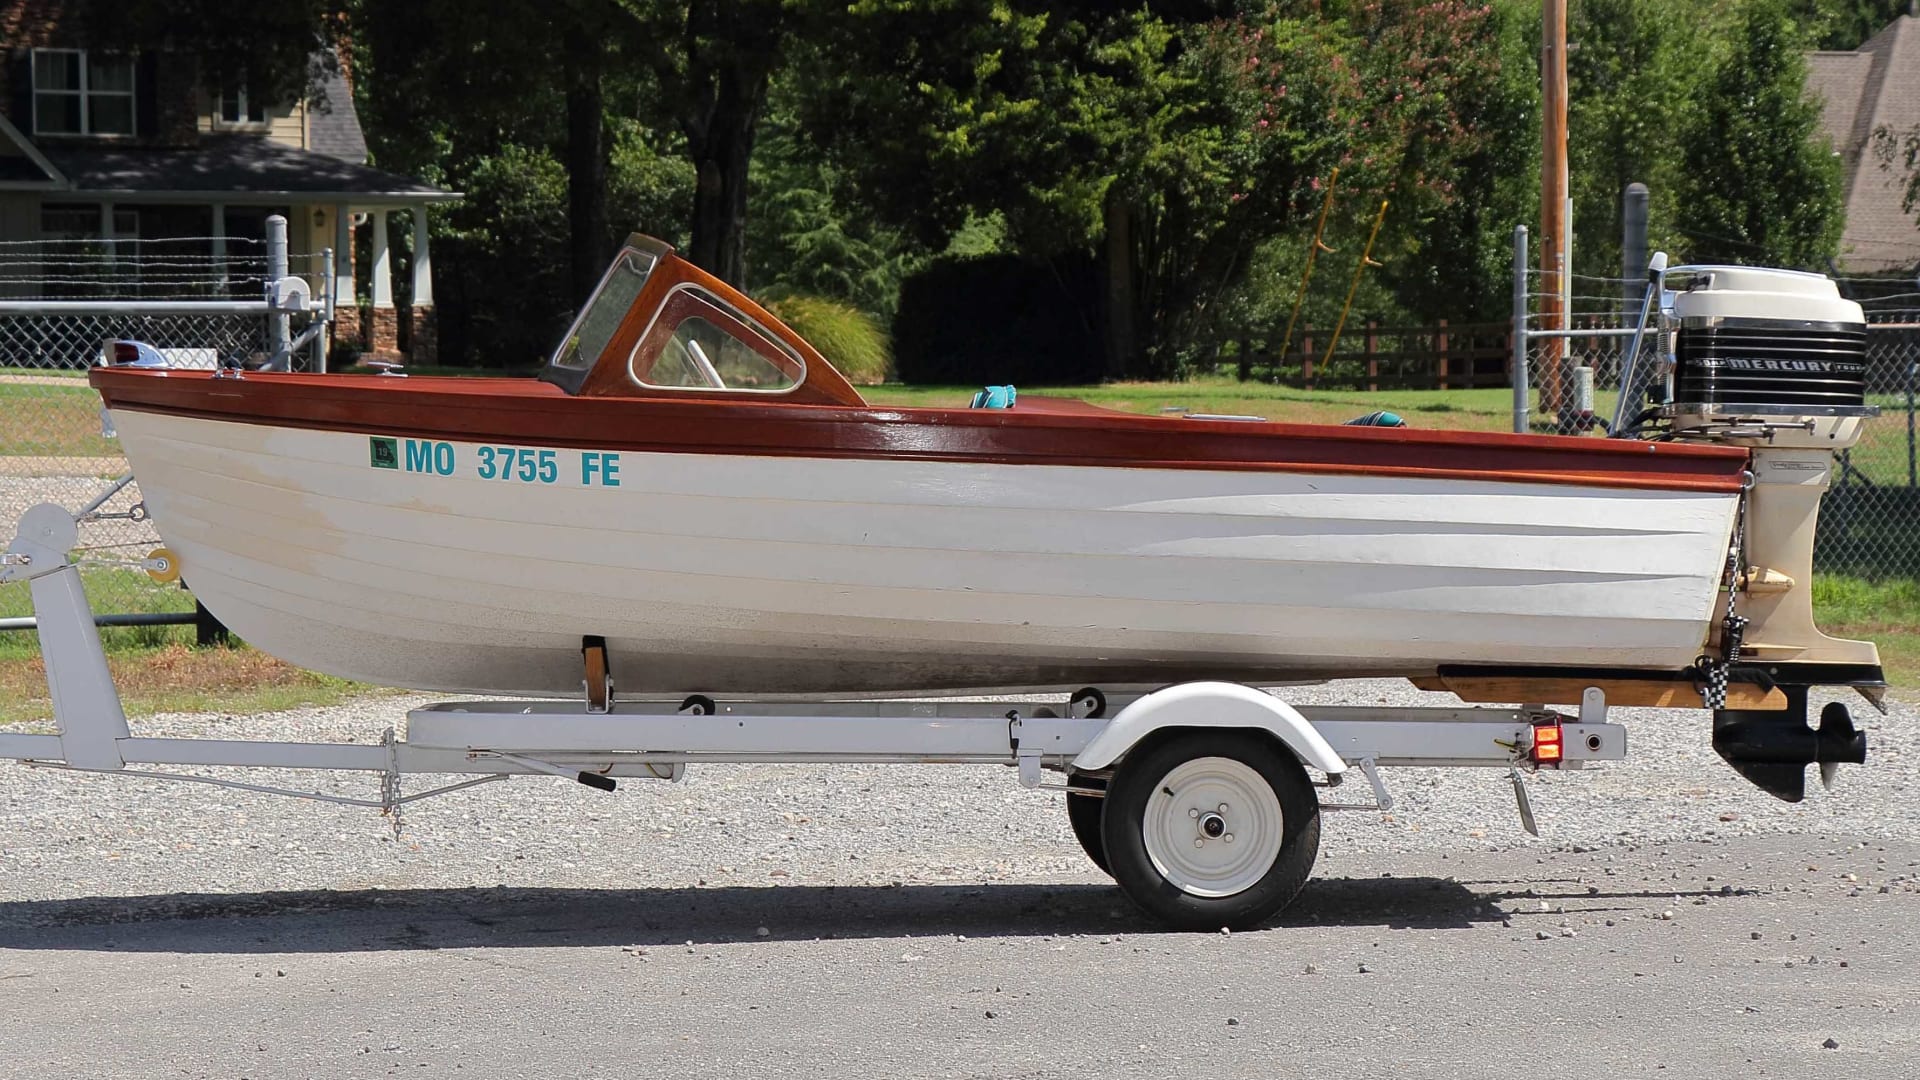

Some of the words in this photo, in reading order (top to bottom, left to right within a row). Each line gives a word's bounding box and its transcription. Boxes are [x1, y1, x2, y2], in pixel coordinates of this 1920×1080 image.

[1730, 359, 1832, 372] MERCURY
[378, 447, 388, 457] 19
[405, 440, 455, 476] MO
[477, 446, 558, 484] 3755
[582, 452, 620, 486] FE
